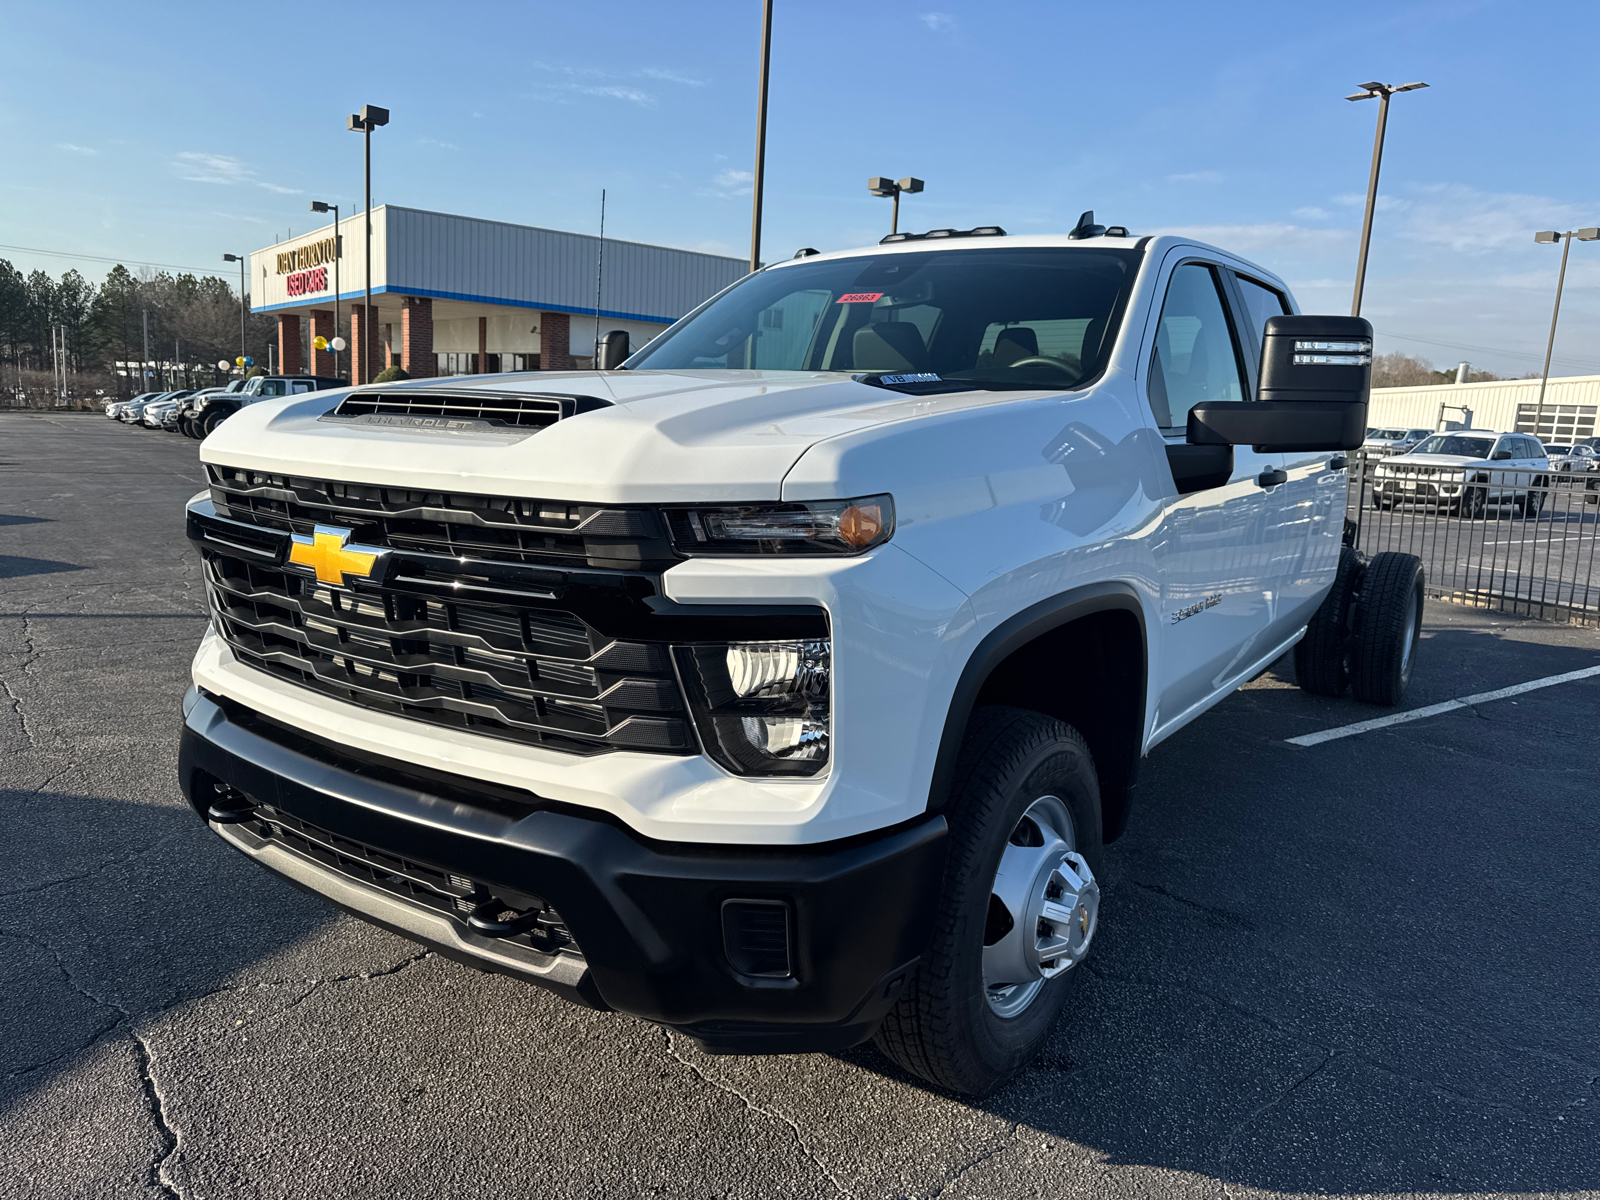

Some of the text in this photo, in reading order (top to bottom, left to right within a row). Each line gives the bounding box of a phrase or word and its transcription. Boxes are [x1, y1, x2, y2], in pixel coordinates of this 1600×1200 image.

[276, 251, 294, 275] JOHN
[286, 267, 326, 296] USED CARS
[367, 415, 473, 430] CHEVROLET
